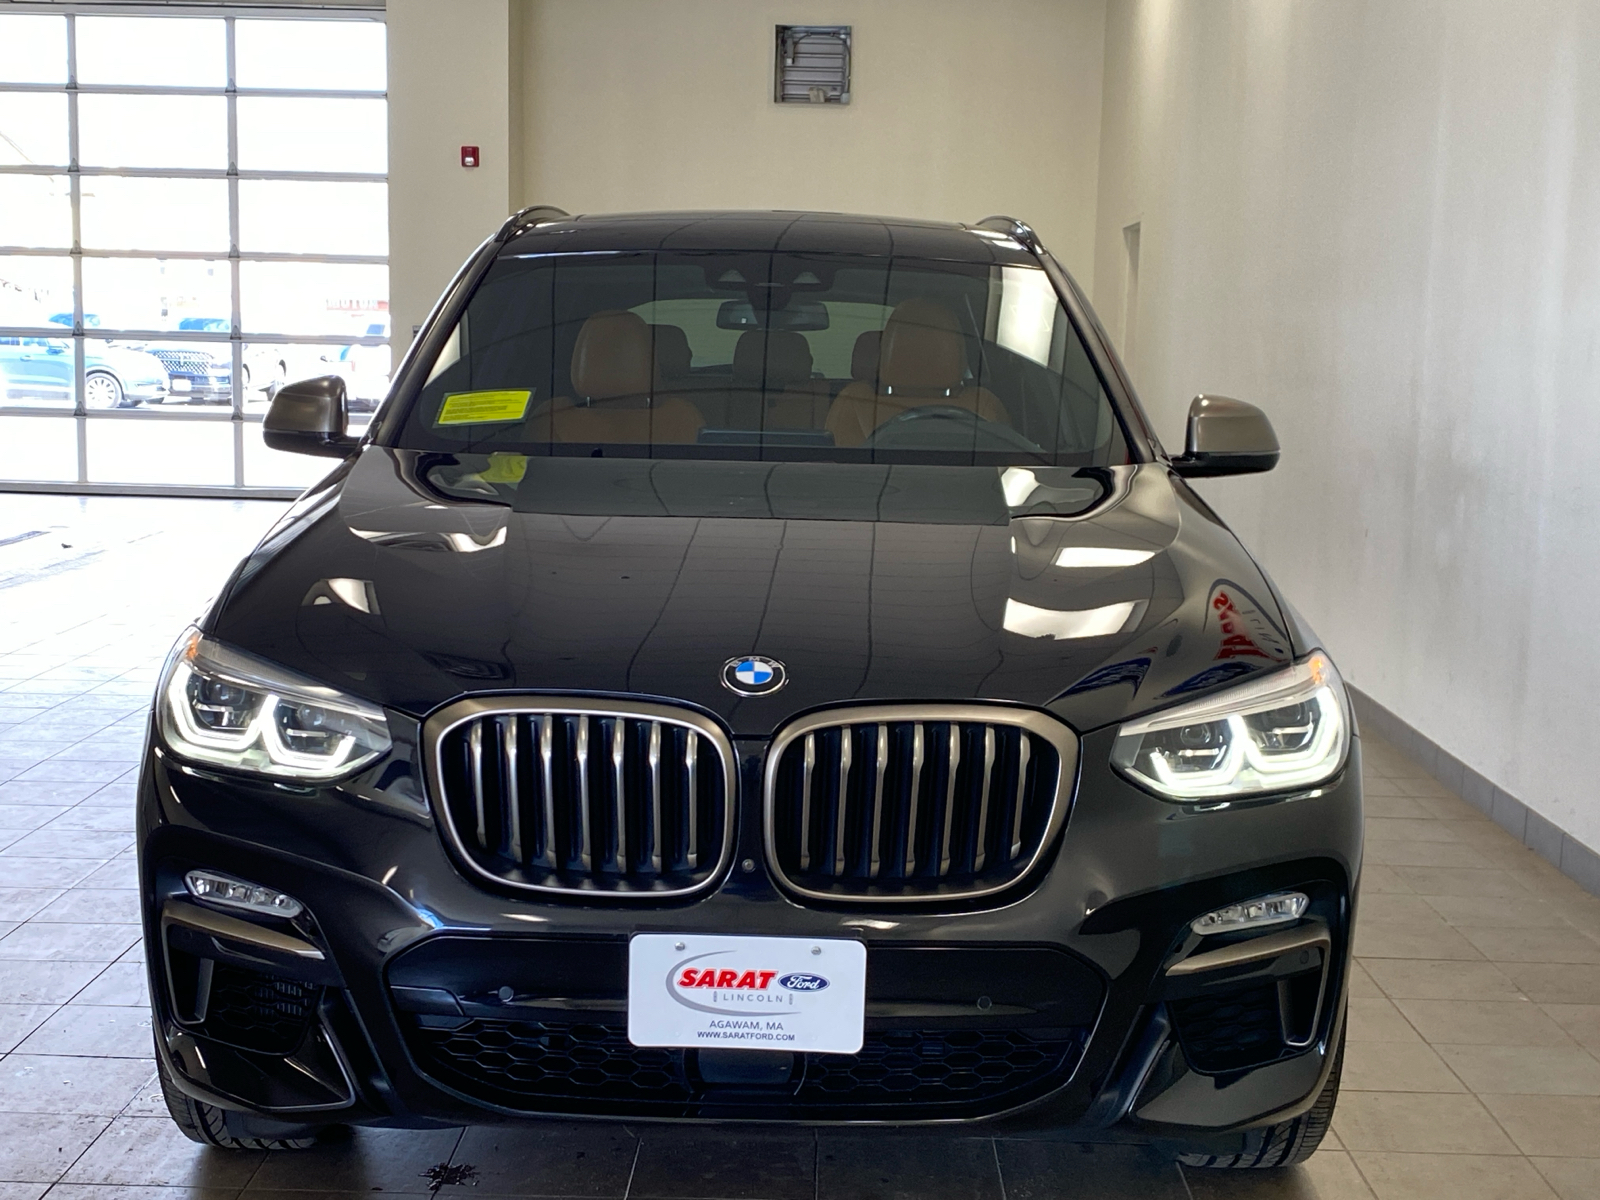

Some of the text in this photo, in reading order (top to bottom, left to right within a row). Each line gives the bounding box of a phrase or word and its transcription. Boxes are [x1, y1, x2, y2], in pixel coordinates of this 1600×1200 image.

[678, 967, 822, 991] SARAT Ford
[723, 993, 784, 1003] LINCOLN
[709, 1020, 784, 1031] AGAWAM, MA
[697, 1031, 796, 1042] WWW.SARATFORD.COM
